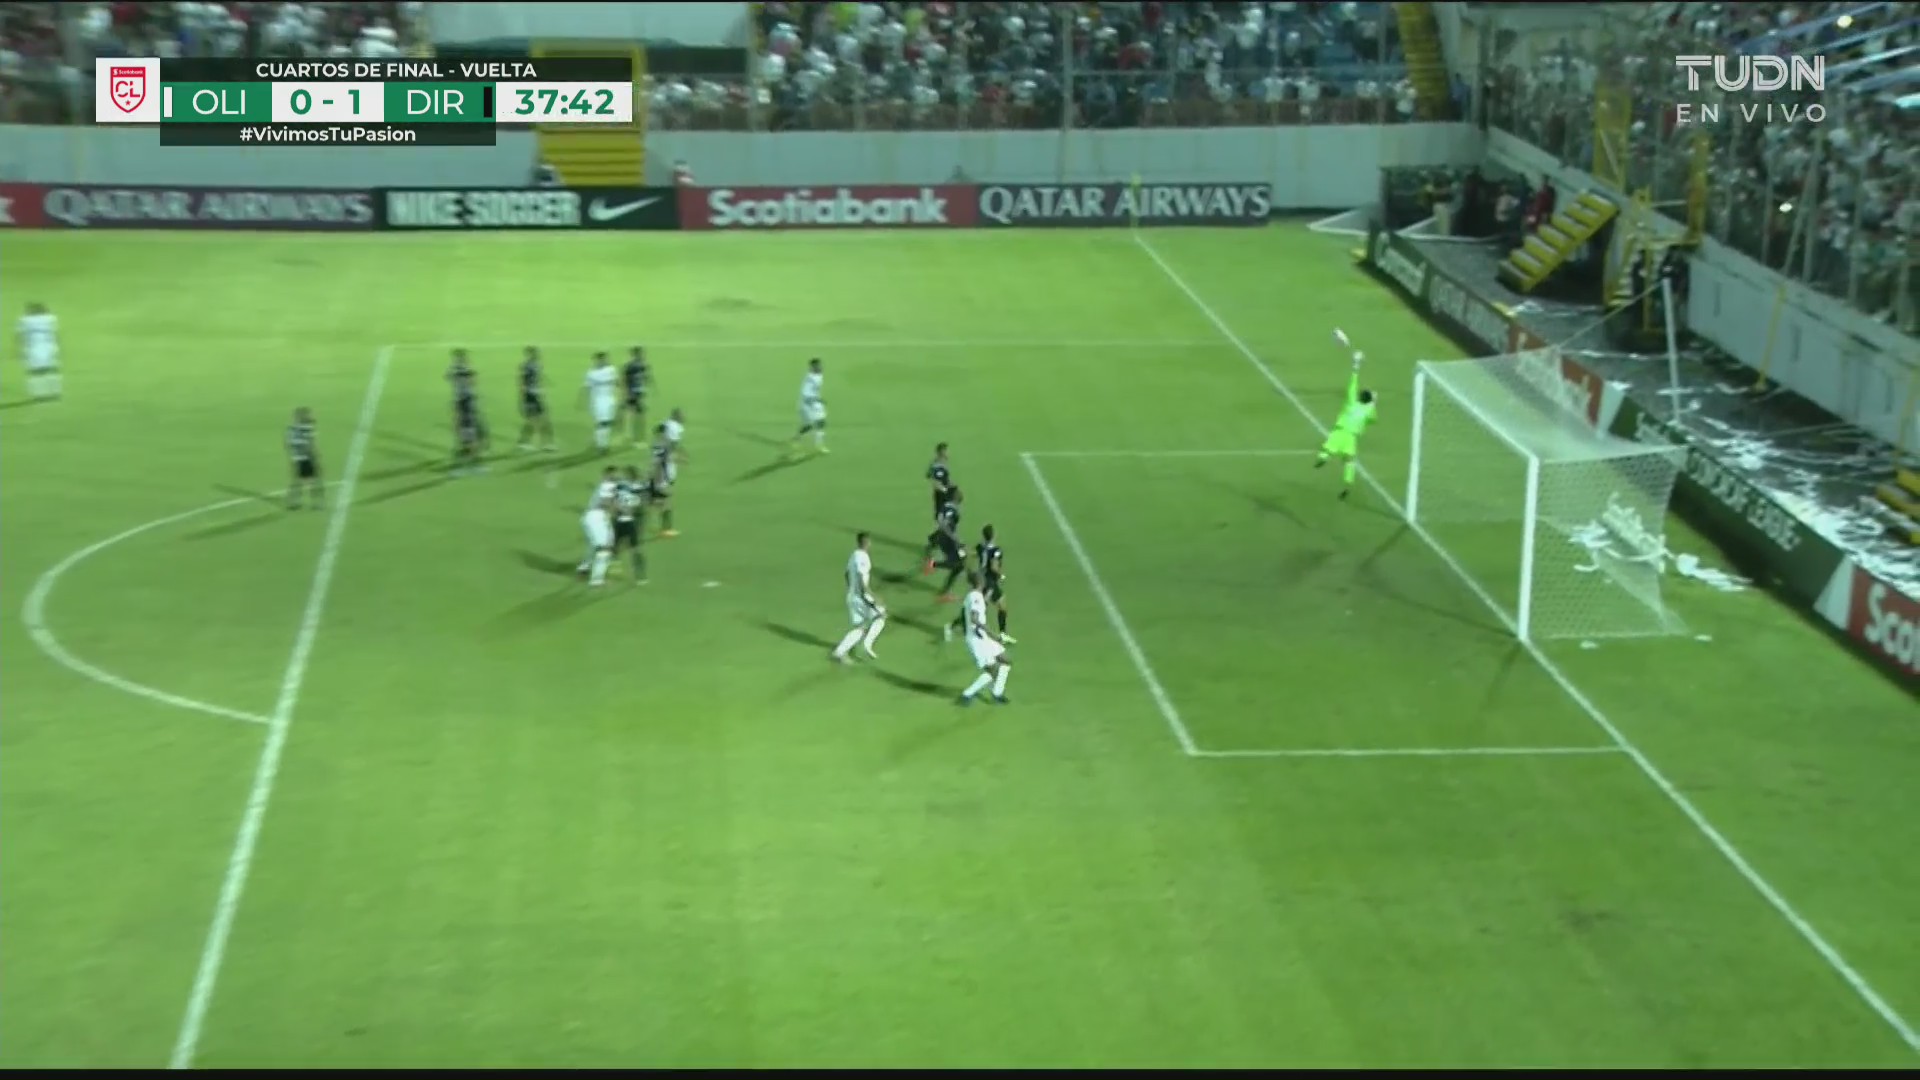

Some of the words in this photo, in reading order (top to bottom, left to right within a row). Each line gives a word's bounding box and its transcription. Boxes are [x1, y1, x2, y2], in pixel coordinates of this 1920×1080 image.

[708, 188, 948, 226] Scotiabank
[979, 186, 1105, 224] QATAR
[1113, 186, 1271, 217] AIRWAYS
